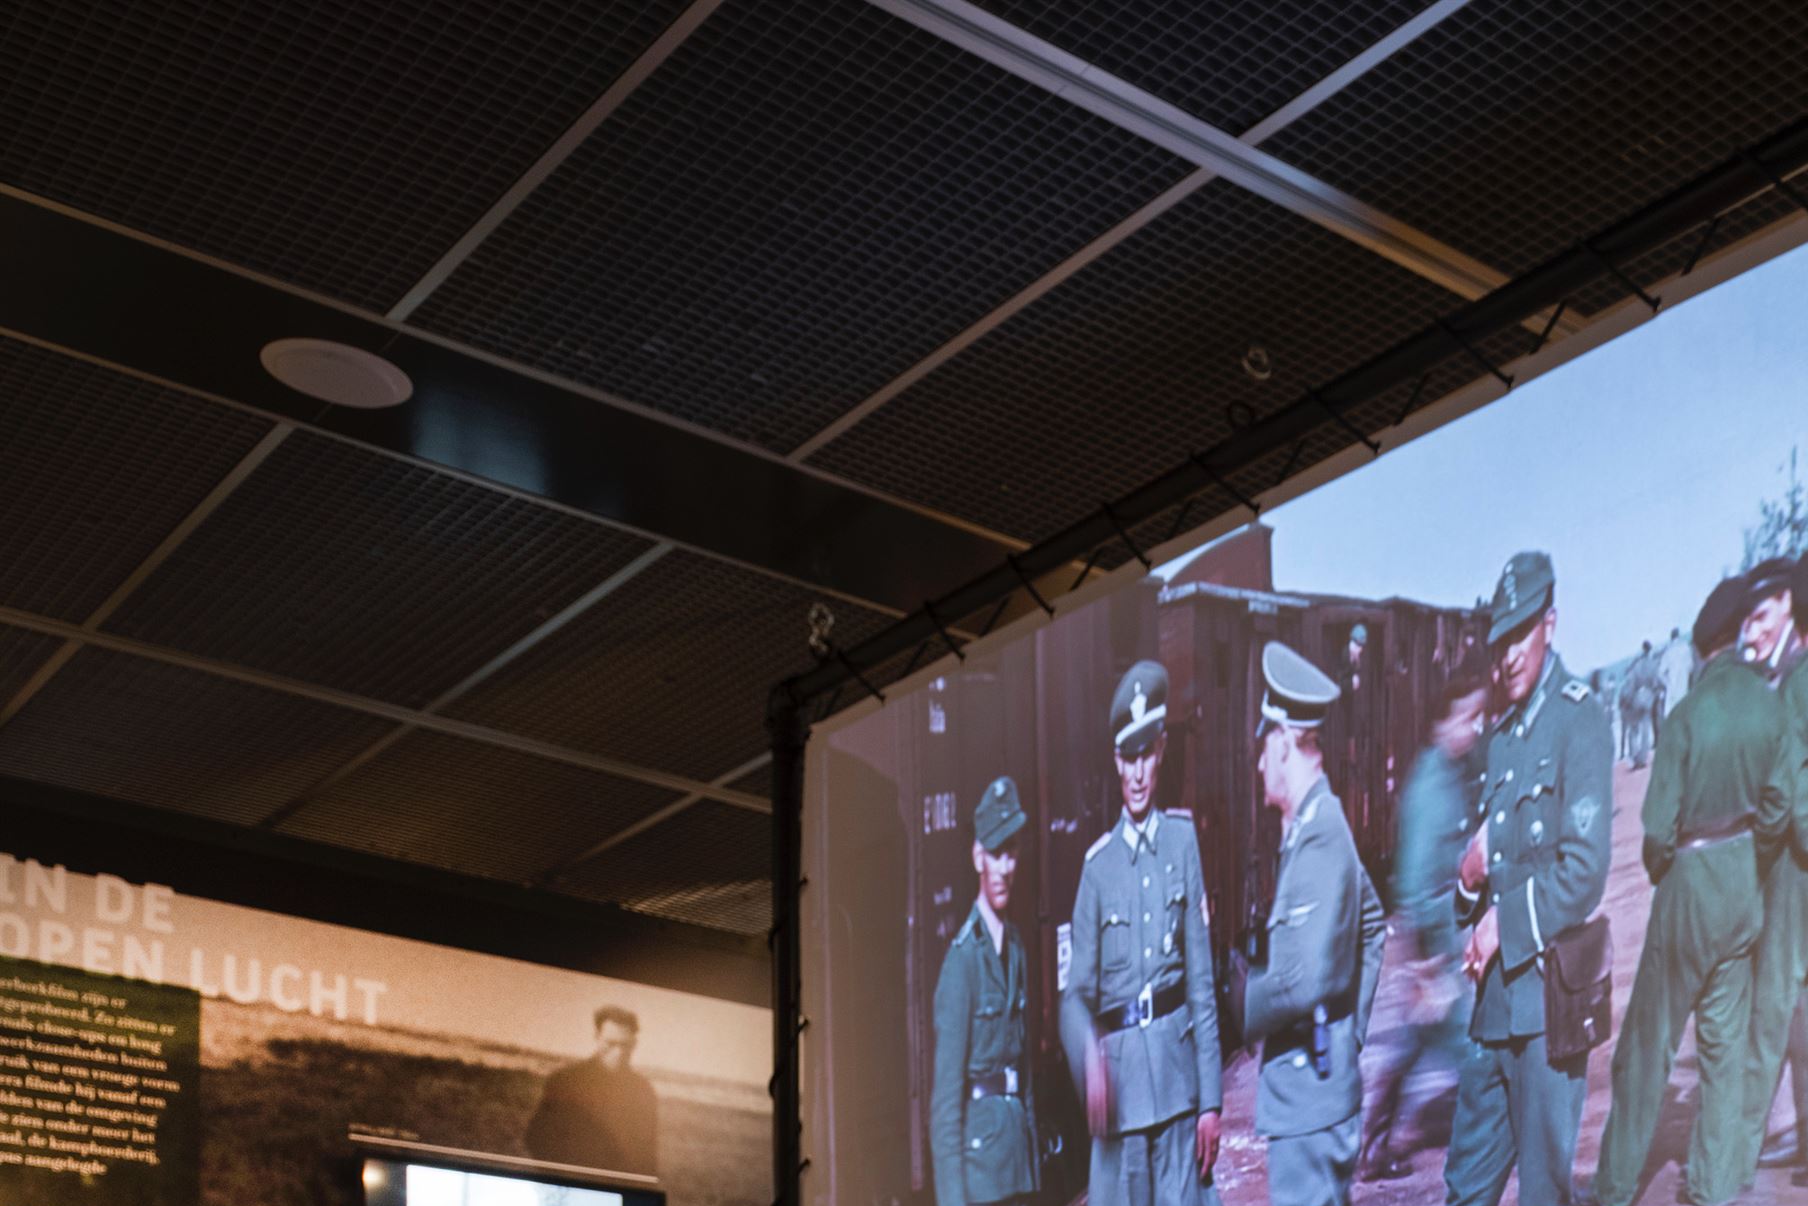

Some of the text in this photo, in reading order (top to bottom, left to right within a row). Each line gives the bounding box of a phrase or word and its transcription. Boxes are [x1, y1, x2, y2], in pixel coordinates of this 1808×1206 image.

[0, 852, 175, 934] IN DE
[0, 912, 388, 1025] OPEN LUCHT
